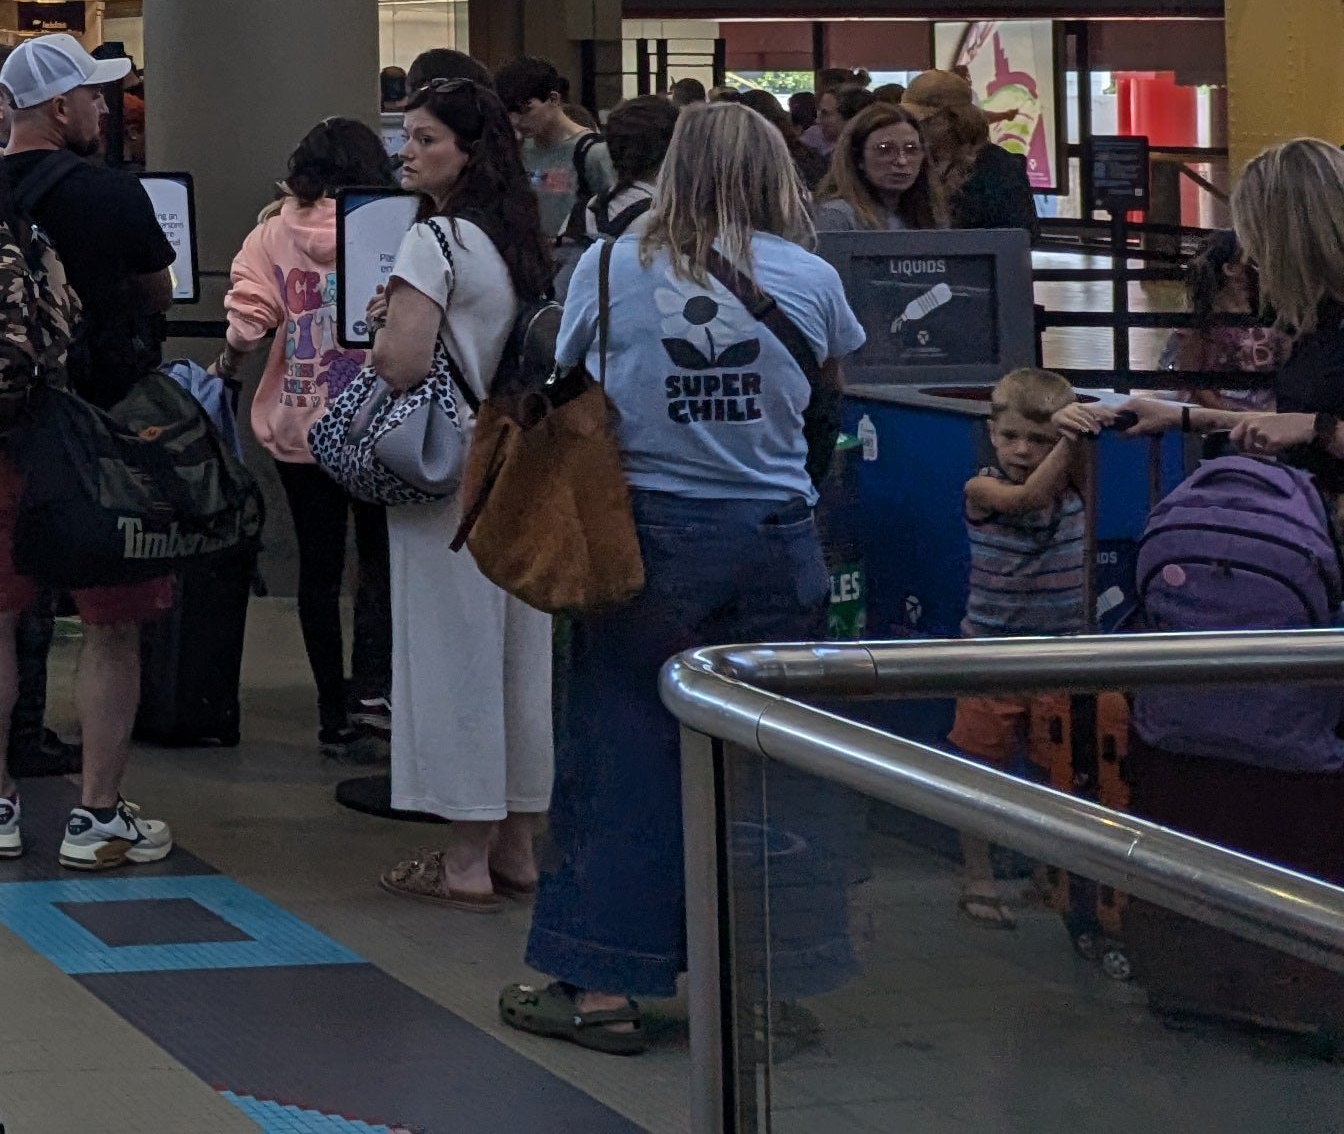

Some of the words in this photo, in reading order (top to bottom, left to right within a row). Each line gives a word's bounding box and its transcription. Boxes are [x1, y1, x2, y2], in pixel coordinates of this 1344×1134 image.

[889, 259, 946, 274] LIQUIDS
[665, 372, 762, 398] SUPER
[667, 398, 762, 424] CHILL
[829, 570, 860, 603] LES
